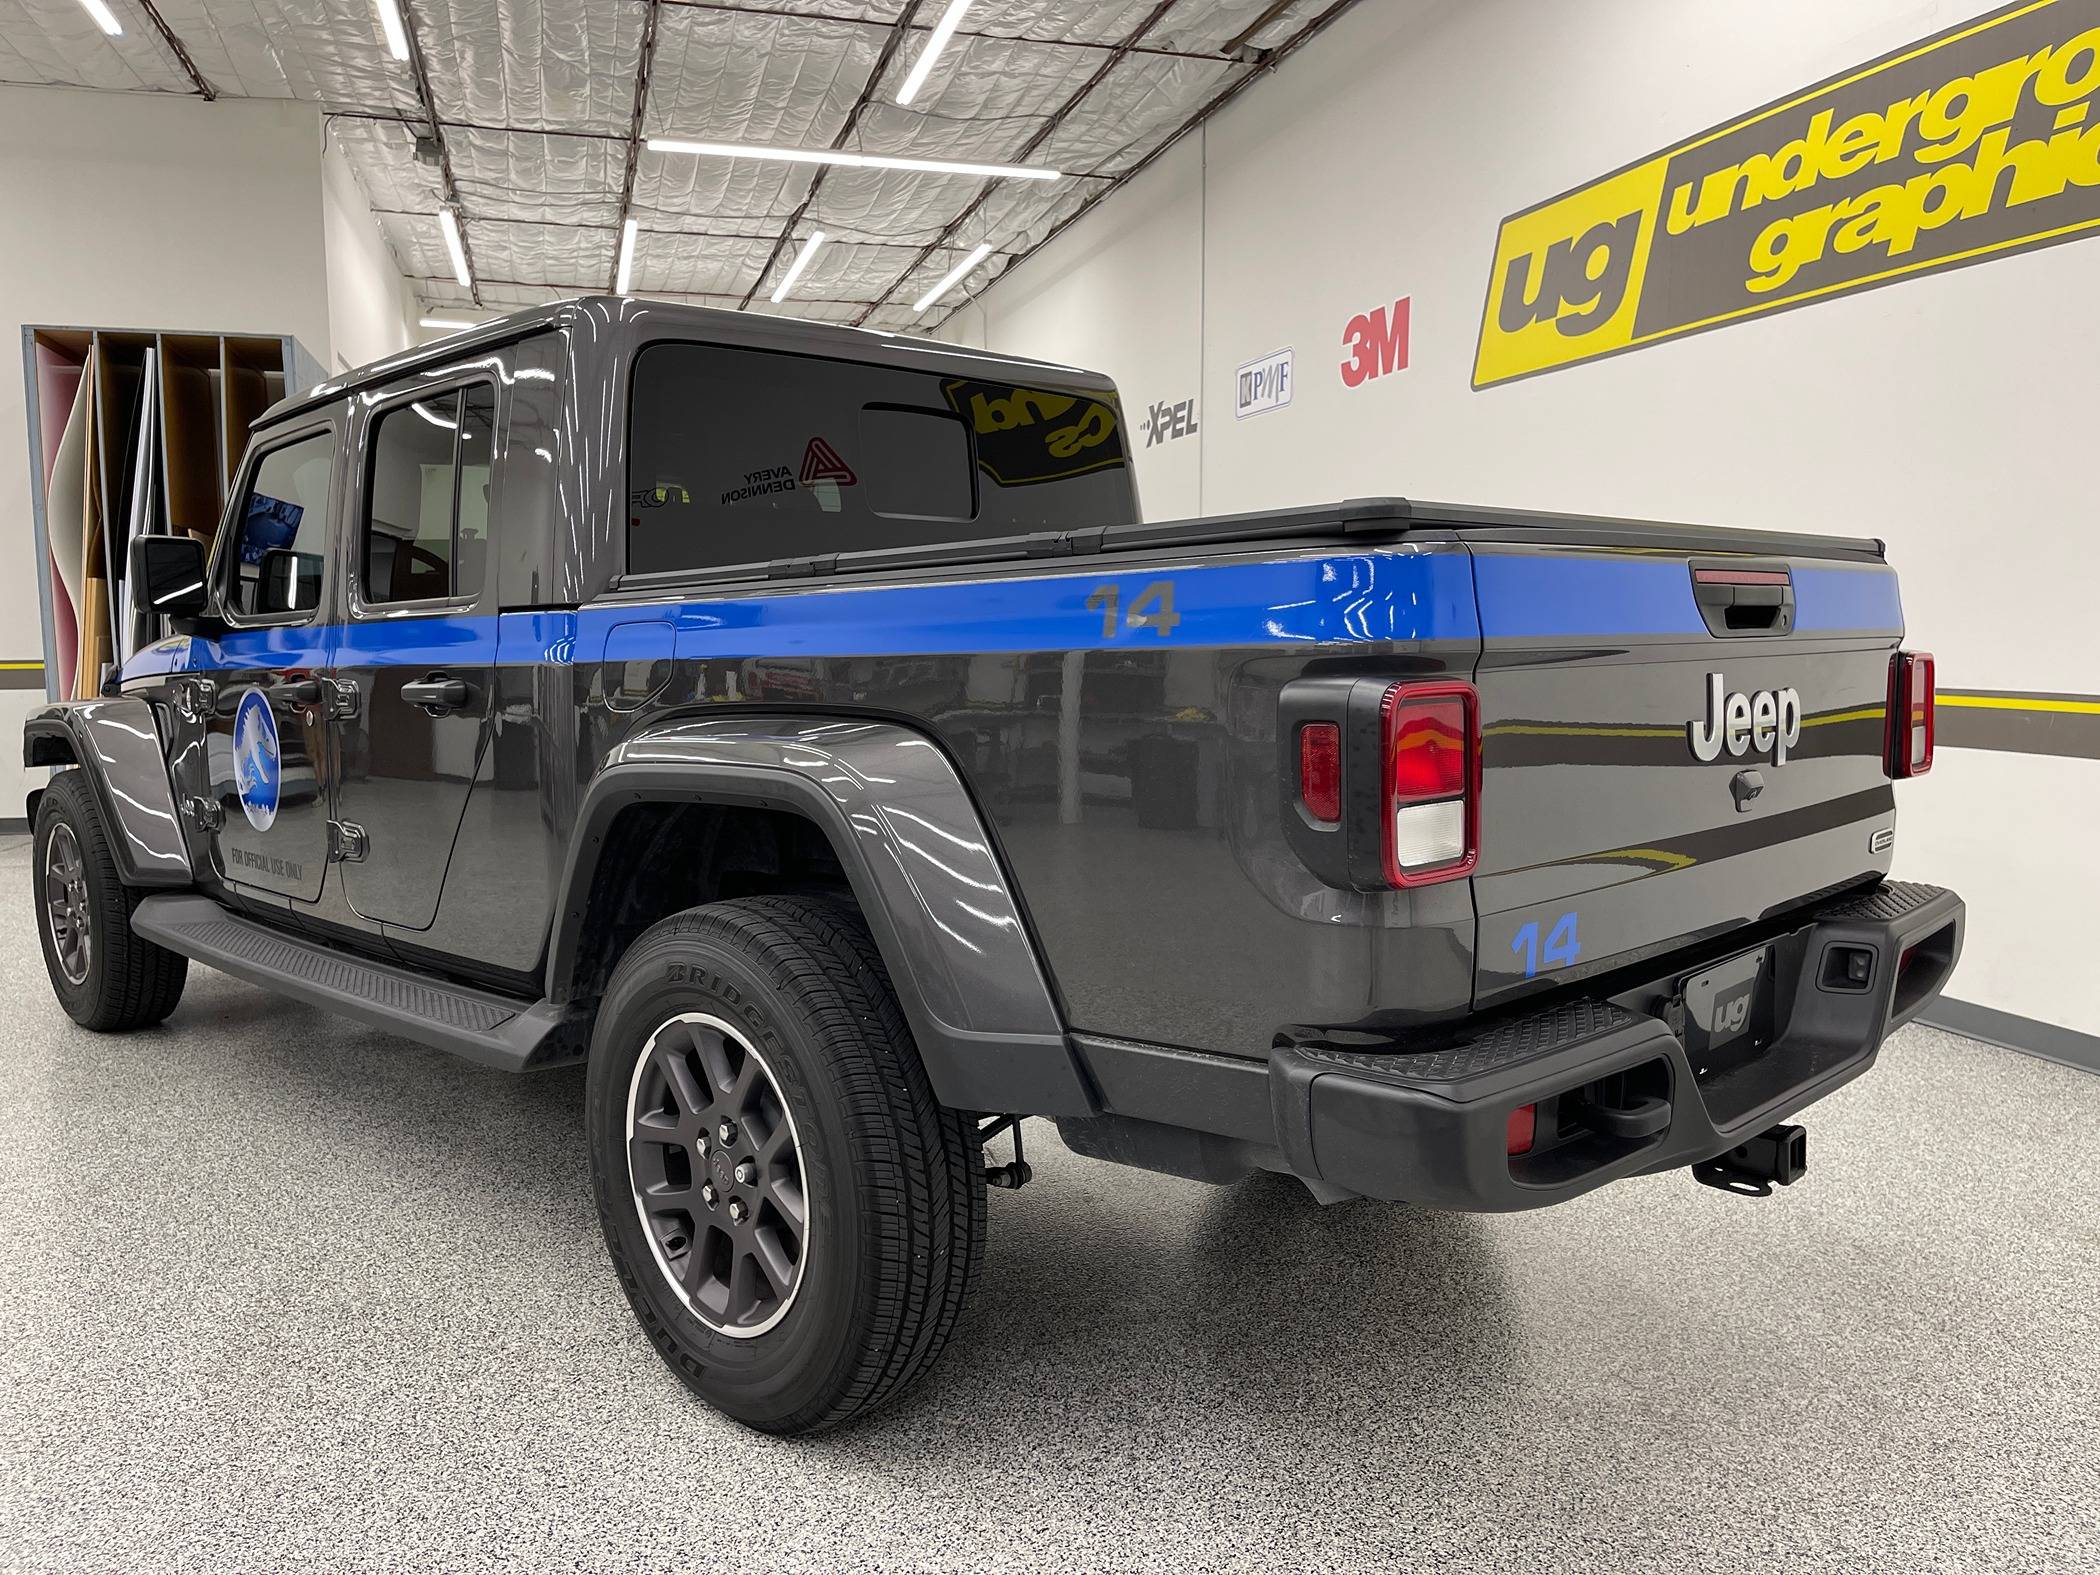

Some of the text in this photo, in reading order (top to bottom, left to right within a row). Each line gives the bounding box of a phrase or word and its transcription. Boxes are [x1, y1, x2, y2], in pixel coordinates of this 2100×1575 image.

[1498, 209, 1643, 337] ug
[1340, 295, 1411, 388] 3M
[1239, 361, 1289, 409] KPMF
[1146, 399, 1198, 449] XPEL
[1086, 581, 1181, 639] 14
[1686, 672, 1801, 767] Jeep
[231, 848, 303, 881] FOR OFFICIAL USE ONLY
[1511, 911, 1582, 979] 14
[1714, 993, 1750, 1033] ug
